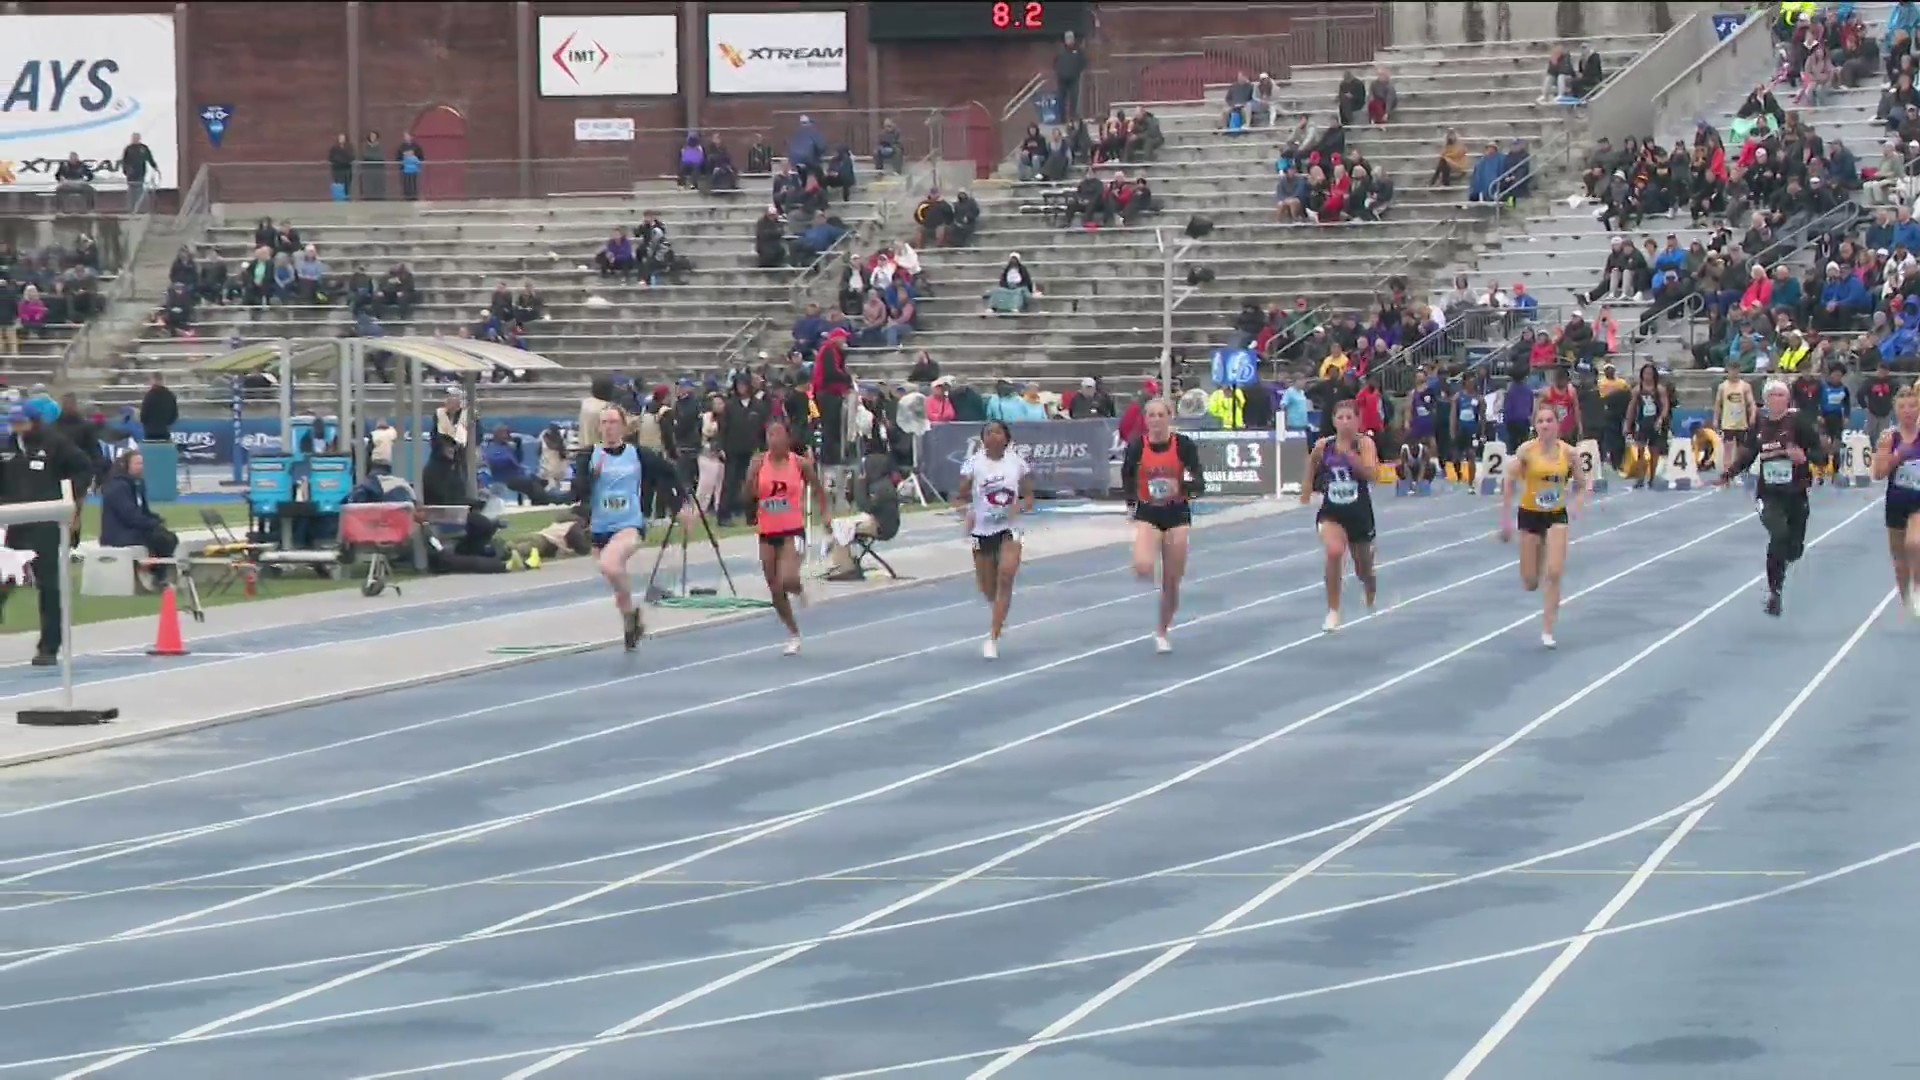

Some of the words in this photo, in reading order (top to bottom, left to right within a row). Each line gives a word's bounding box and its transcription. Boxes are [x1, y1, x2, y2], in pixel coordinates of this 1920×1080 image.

[992, 2, 1042, 27] 8.2
[568, 50, 595, 62] IMT
[747, 47, 844, 59] XTREAM
[1033, 442, 1088, 458] RELAYS
[1225, 443, 1262, 468] 8.3
[1673, 449, 1688, 470] 4
[1488, 453, 1503, 475] 2
[1579, 451, 1593, 472] 3
